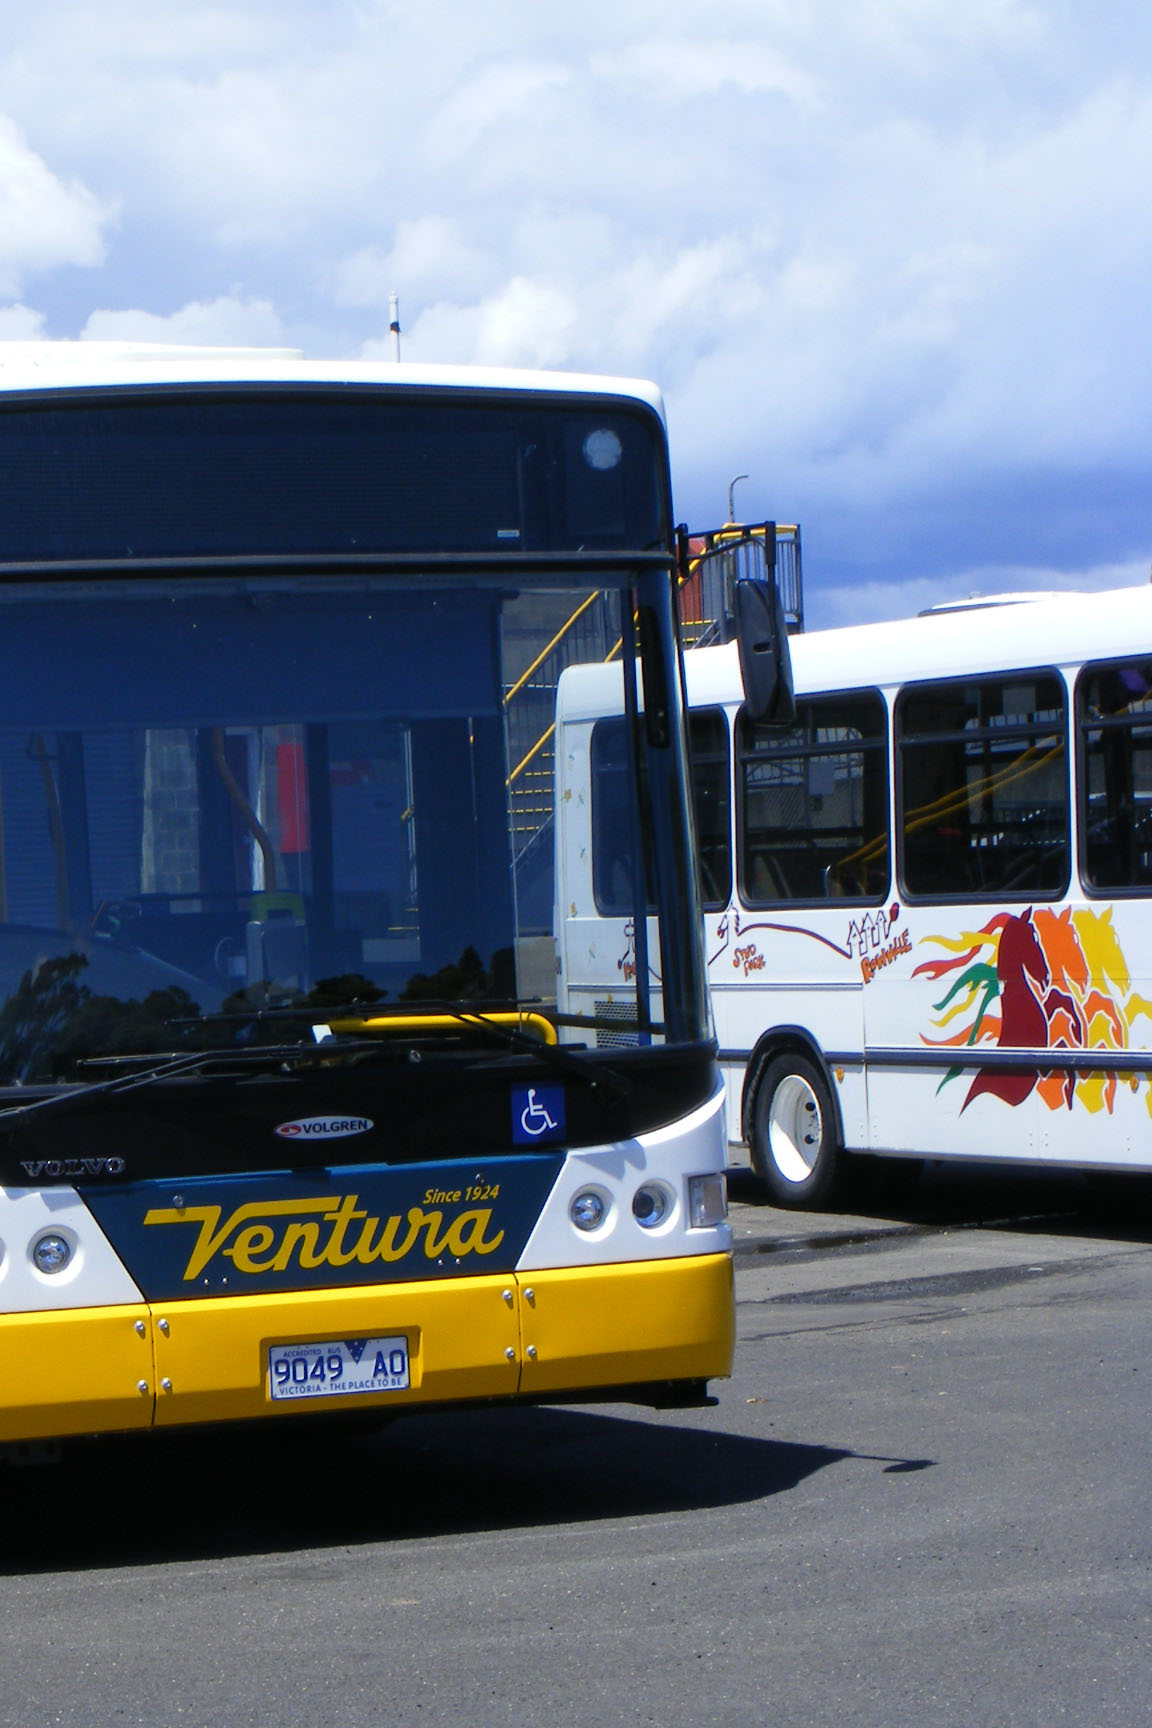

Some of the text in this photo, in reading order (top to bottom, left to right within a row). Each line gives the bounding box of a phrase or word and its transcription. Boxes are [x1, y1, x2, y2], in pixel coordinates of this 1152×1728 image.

[302, 1119, 368, 1134] VOLGREN
[19, 1157, 125, 1177] VOLVO
[422, 1184, 500, 1205] Since 1924
[143, 1195, 504, 1281] Ventura
[283, 1348, 322, 1358] ACCREDITED
[274, 1355, 344, 1385] 9049
[279, 1384, 322, 1395] VICTORIA
[330, 1381, 346, 1391] THE
[348, 1379, 375, 1389] PLACE
[378, 1378, 389, 1387] TO
[391, 1378, 402, 1386] BE
